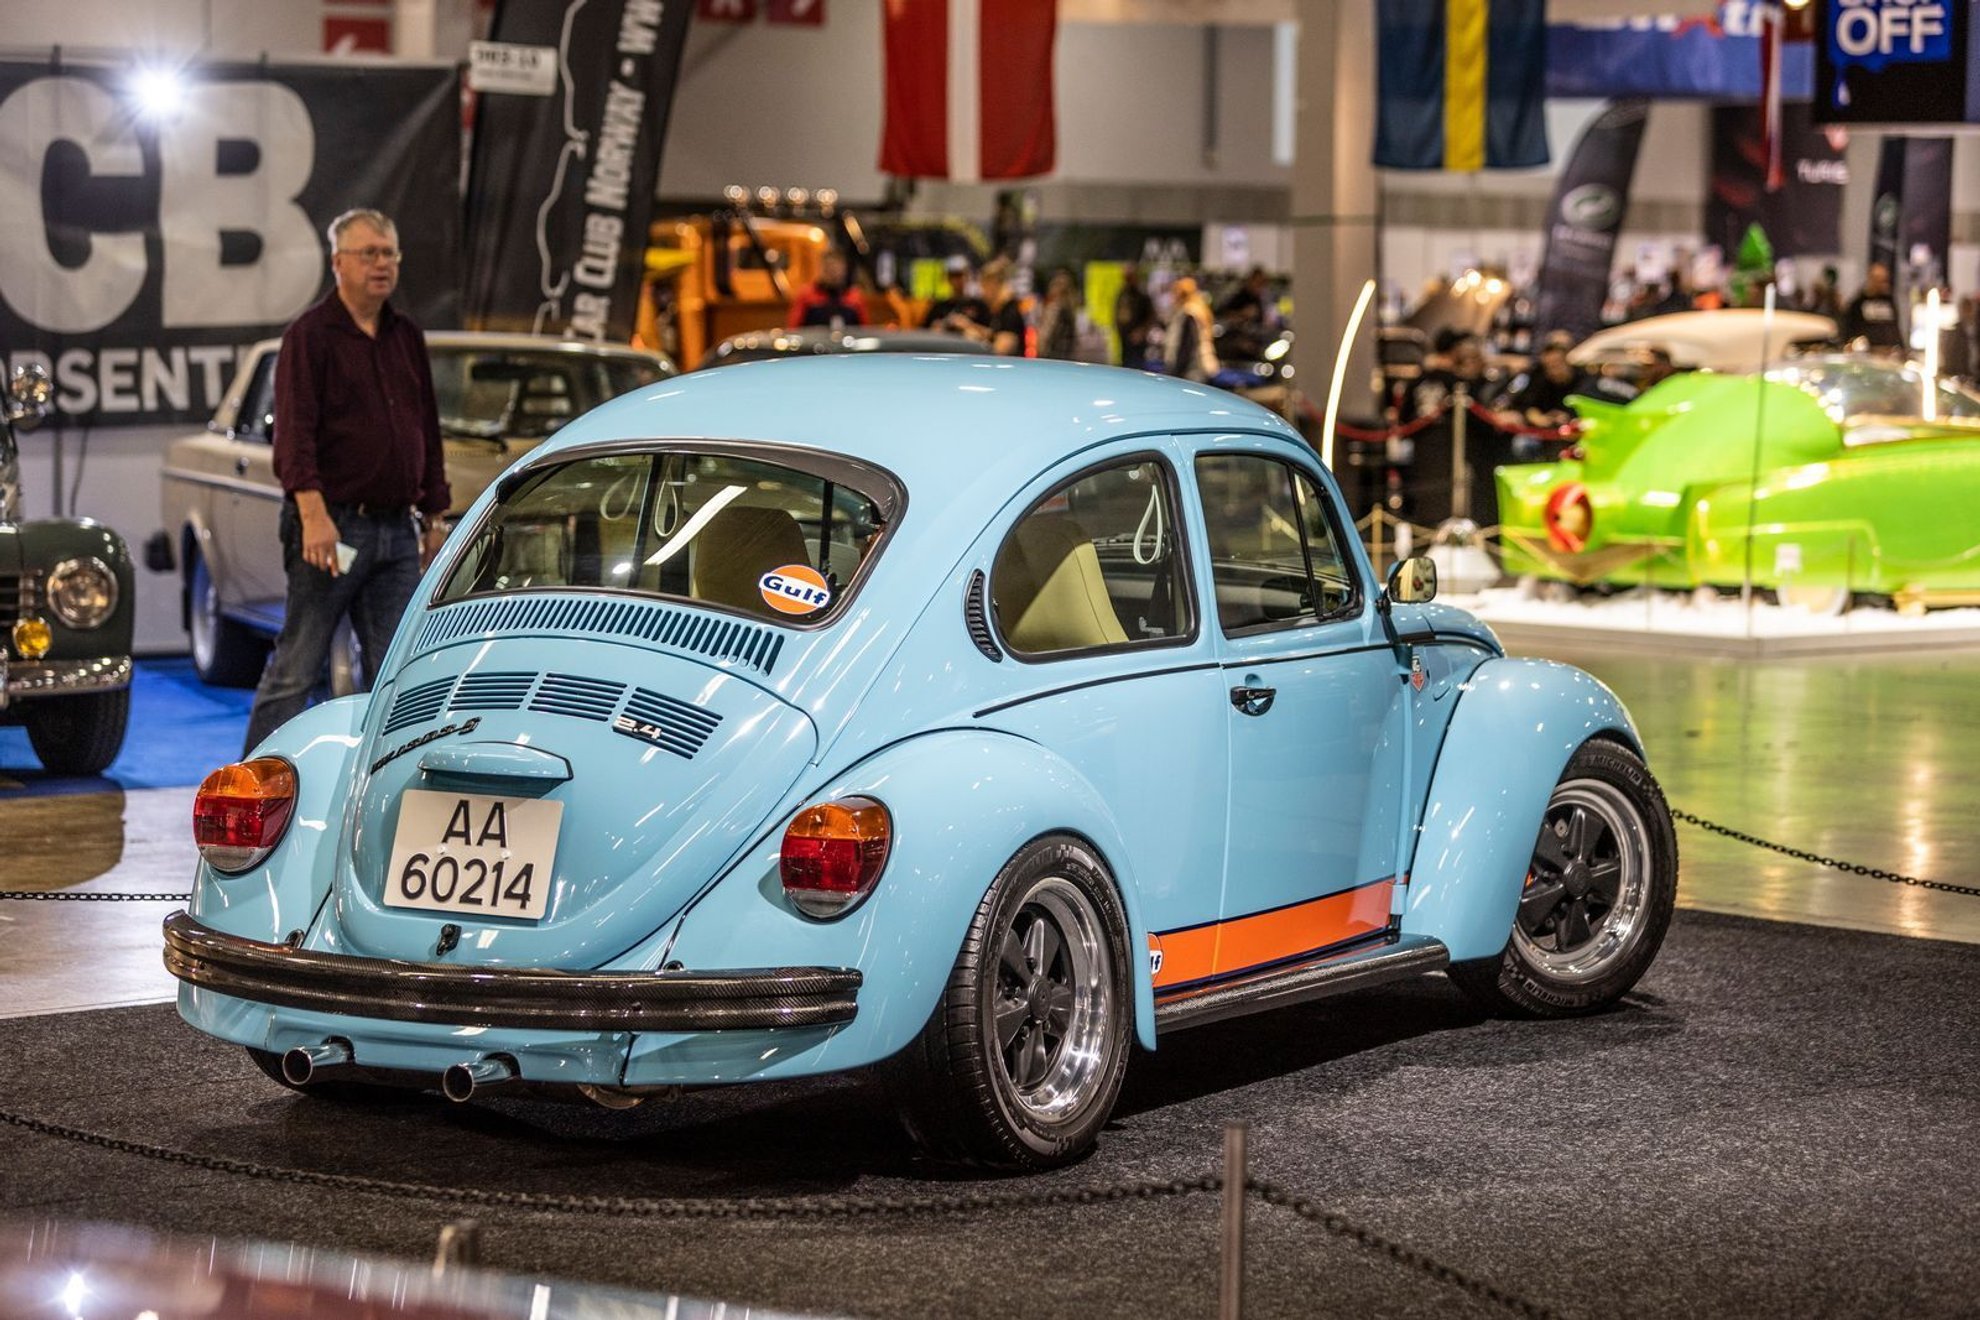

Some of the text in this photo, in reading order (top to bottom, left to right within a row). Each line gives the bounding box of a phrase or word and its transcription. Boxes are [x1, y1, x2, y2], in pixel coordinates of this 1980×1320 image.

[1836, 5, 1945, 56] OFF
[585, 79, 646, 210] NORWAY
[574, 212, 625, 289] CLUB
[762, 575, 828, 605] Gulf
[612, 715, 662, 740] 2.4
[440, 799, 508, 848] AA
[400, 852, 535, 910] 60214
